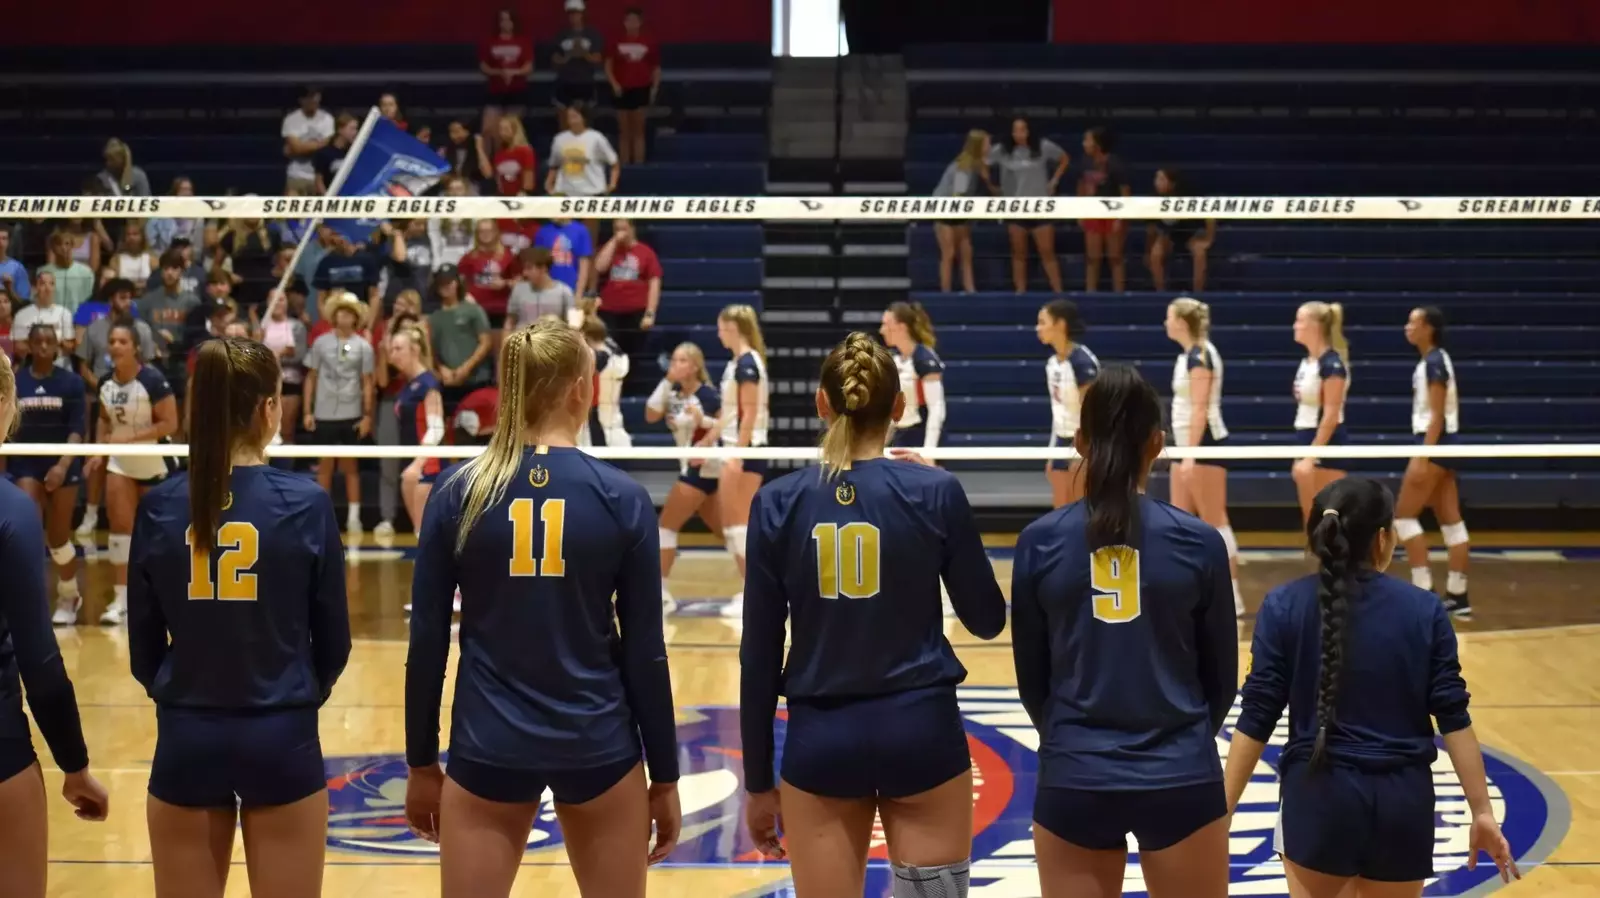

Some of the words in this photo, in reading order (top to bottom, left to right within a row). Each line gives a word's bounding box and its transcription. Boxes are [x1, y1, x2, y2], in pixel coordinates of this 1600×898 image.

[91, 199, 160, 212] EAGLES
[263, 199, 376, 213] SCREAMING
[387, 199, 456, 213] EAGLES
[560, 199, 674, 213] SCREAMING
[686, 199, 756, 213] EAGLES
[860, 199, 974, 213] SCREAMING
[986, 199, 1056, 213] EAGLES
[1160, 199, 1274, 213] SCREAMING
[1285, 199, 1355, 213] EAGLES
[1459, 199, 1572, 213] SCREAMING
[114, 406, 128, 425] 2
[509, 498, 566, 577] 11
[185, 521, 259, 601] 12
[811, 522, 880, 599] 10
[1089, 544, 1141, 624] 9
